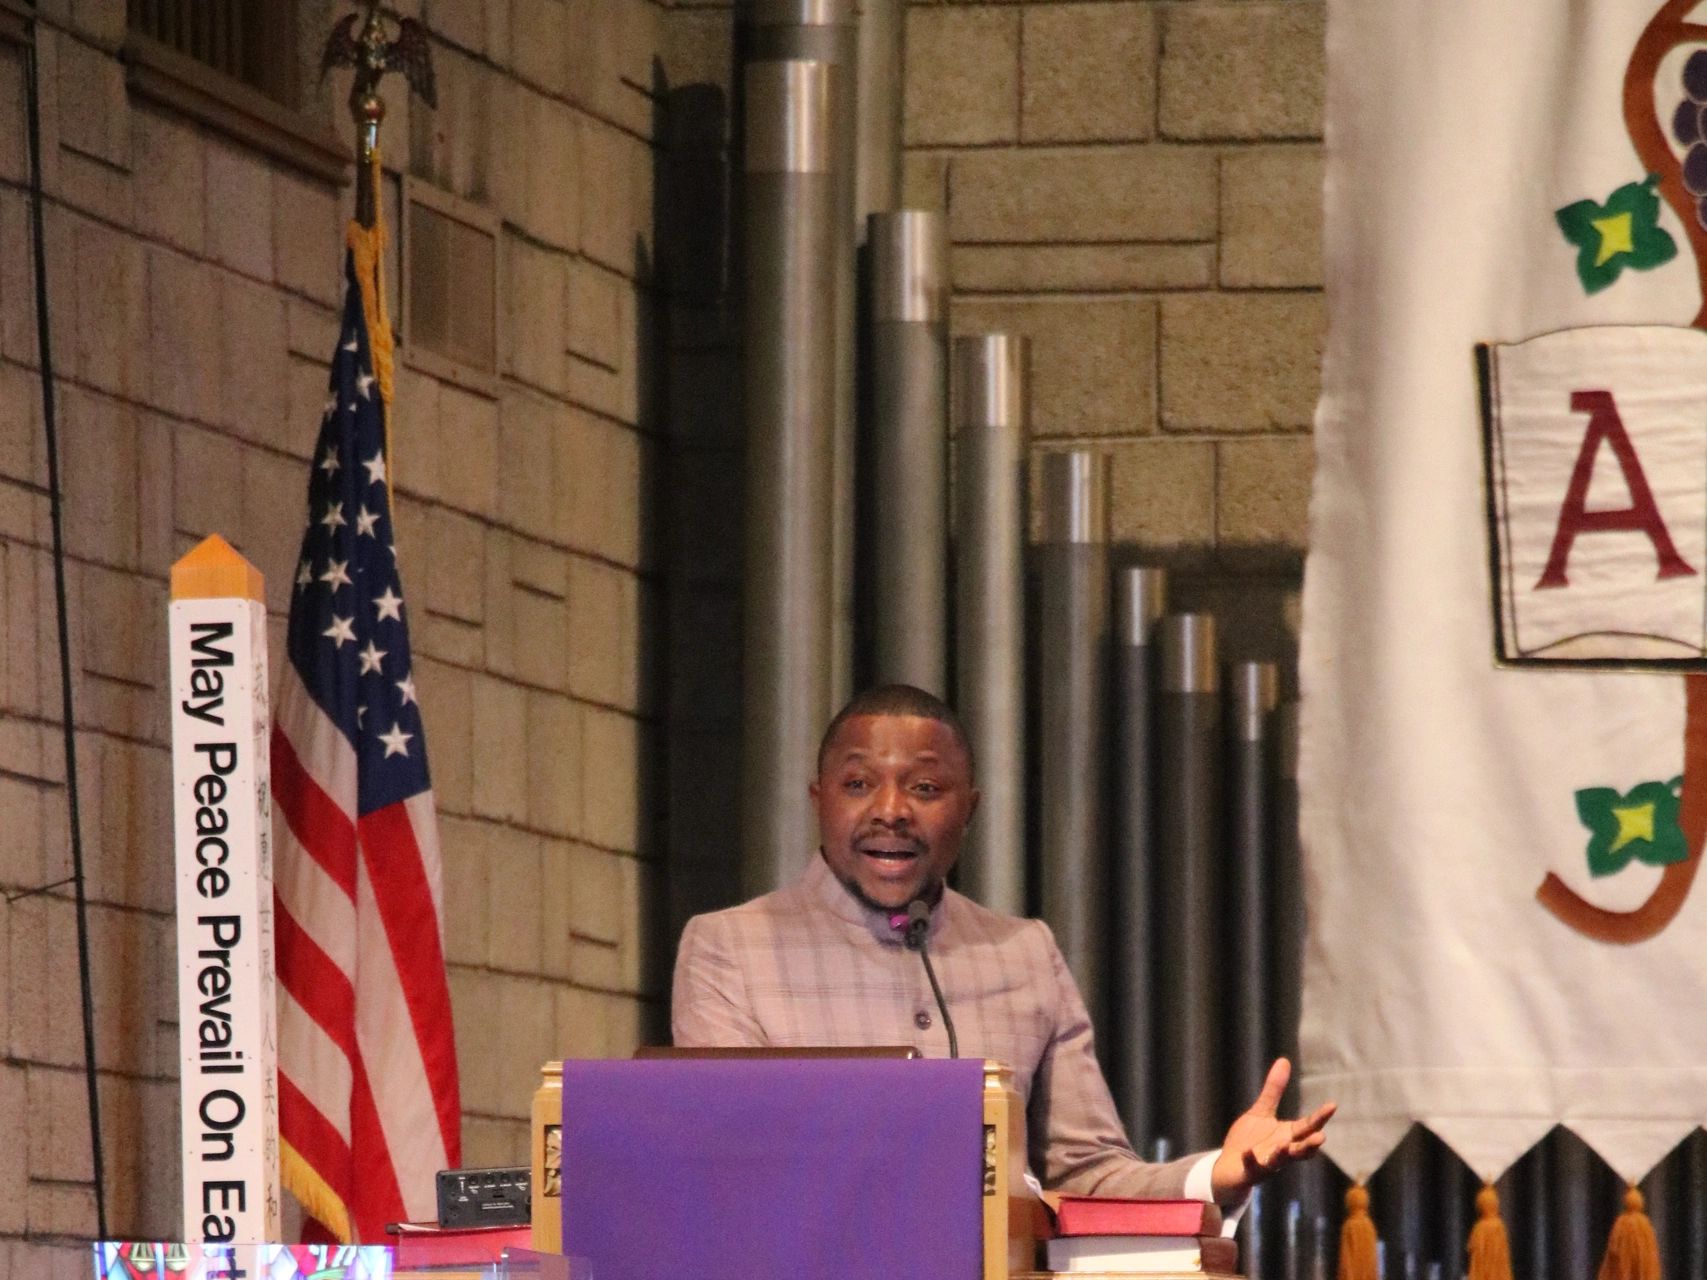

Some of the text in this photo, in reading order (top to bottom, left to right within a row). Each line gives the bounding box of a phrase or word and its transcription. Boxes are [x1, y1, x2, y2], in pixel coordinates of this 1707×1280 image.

[1533, 391, 1697, 591] A
[182, 622, 234, 726] May
[194, 742, 238, 898] Peace
[197, 915, 244, 1074] Prevail
[199, 1089, 246, 1161] On
